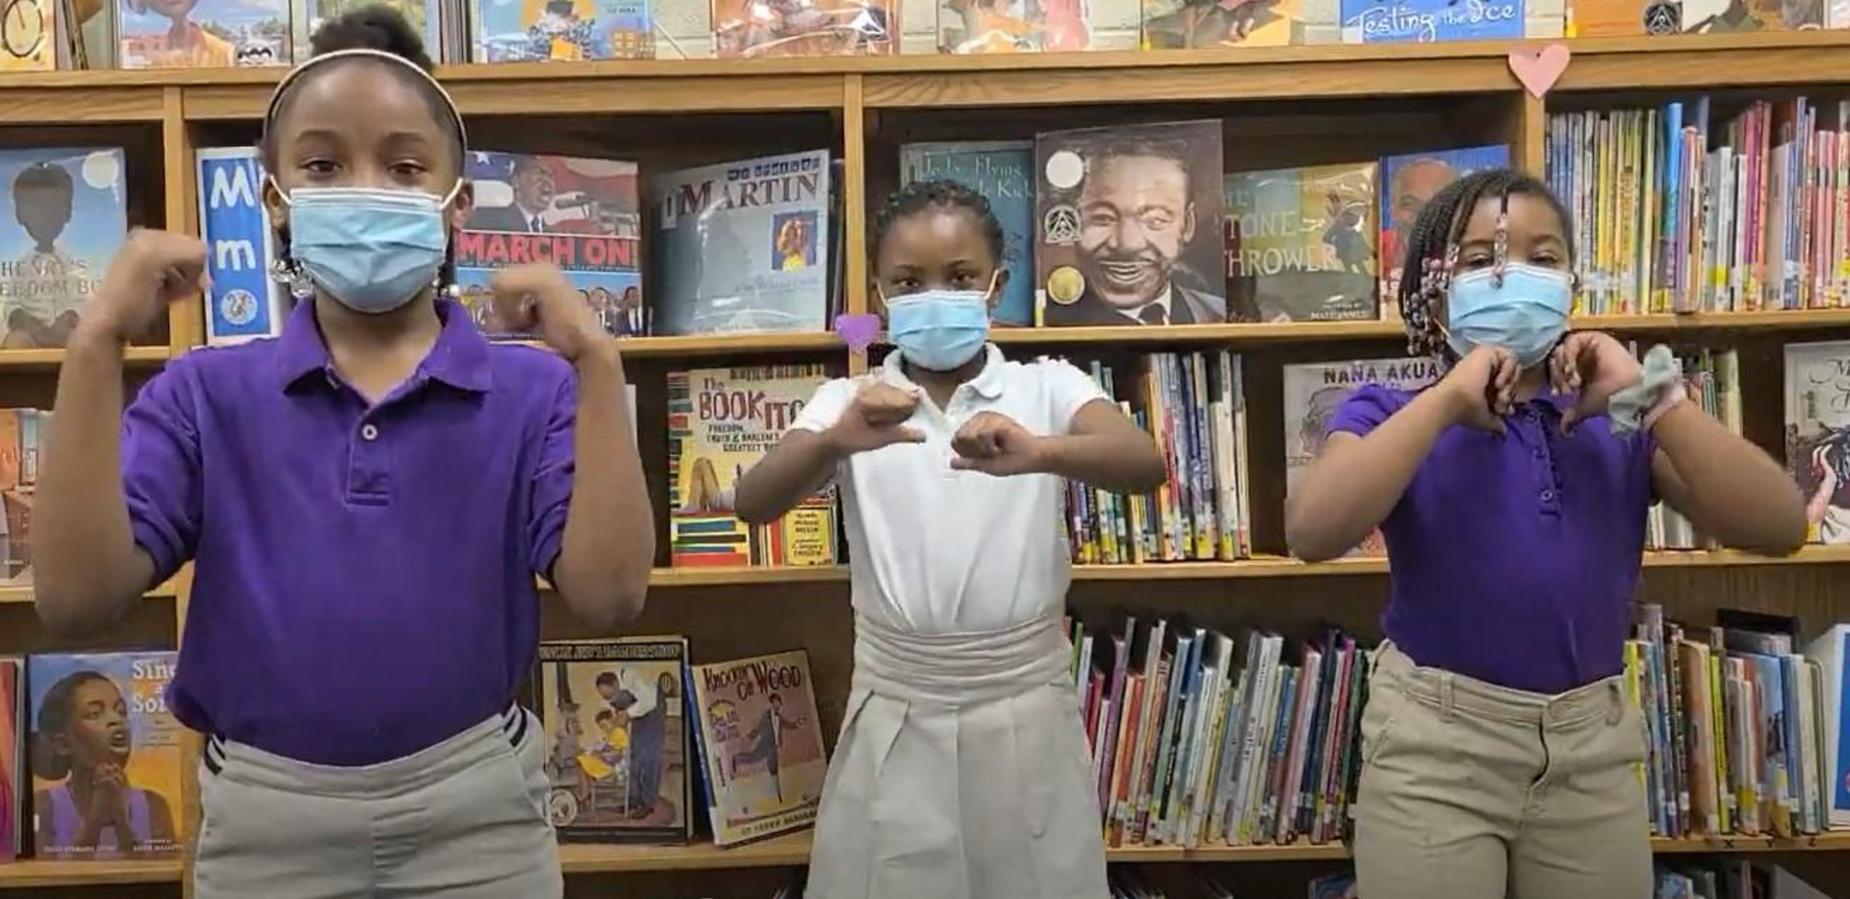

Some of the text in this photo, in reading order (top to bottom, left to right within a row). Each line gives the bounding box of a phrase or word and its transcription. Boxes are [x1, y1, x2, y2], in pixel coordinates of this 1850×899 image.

[1345, 0, 1516, 43] Testing the Ice
[211, 165, 255, 209] M
[677, 172, 818, 216] MARTIN
[1222, 210, 1297, 239] TONE
[216, 239, 257, 271] m
[456, 233, 576, 265] MARCH
[704, 377, 724, 391] The
[1324, 362, 1438, 384] NANA AKUA
[699, 389, 766, 421] BOOK
